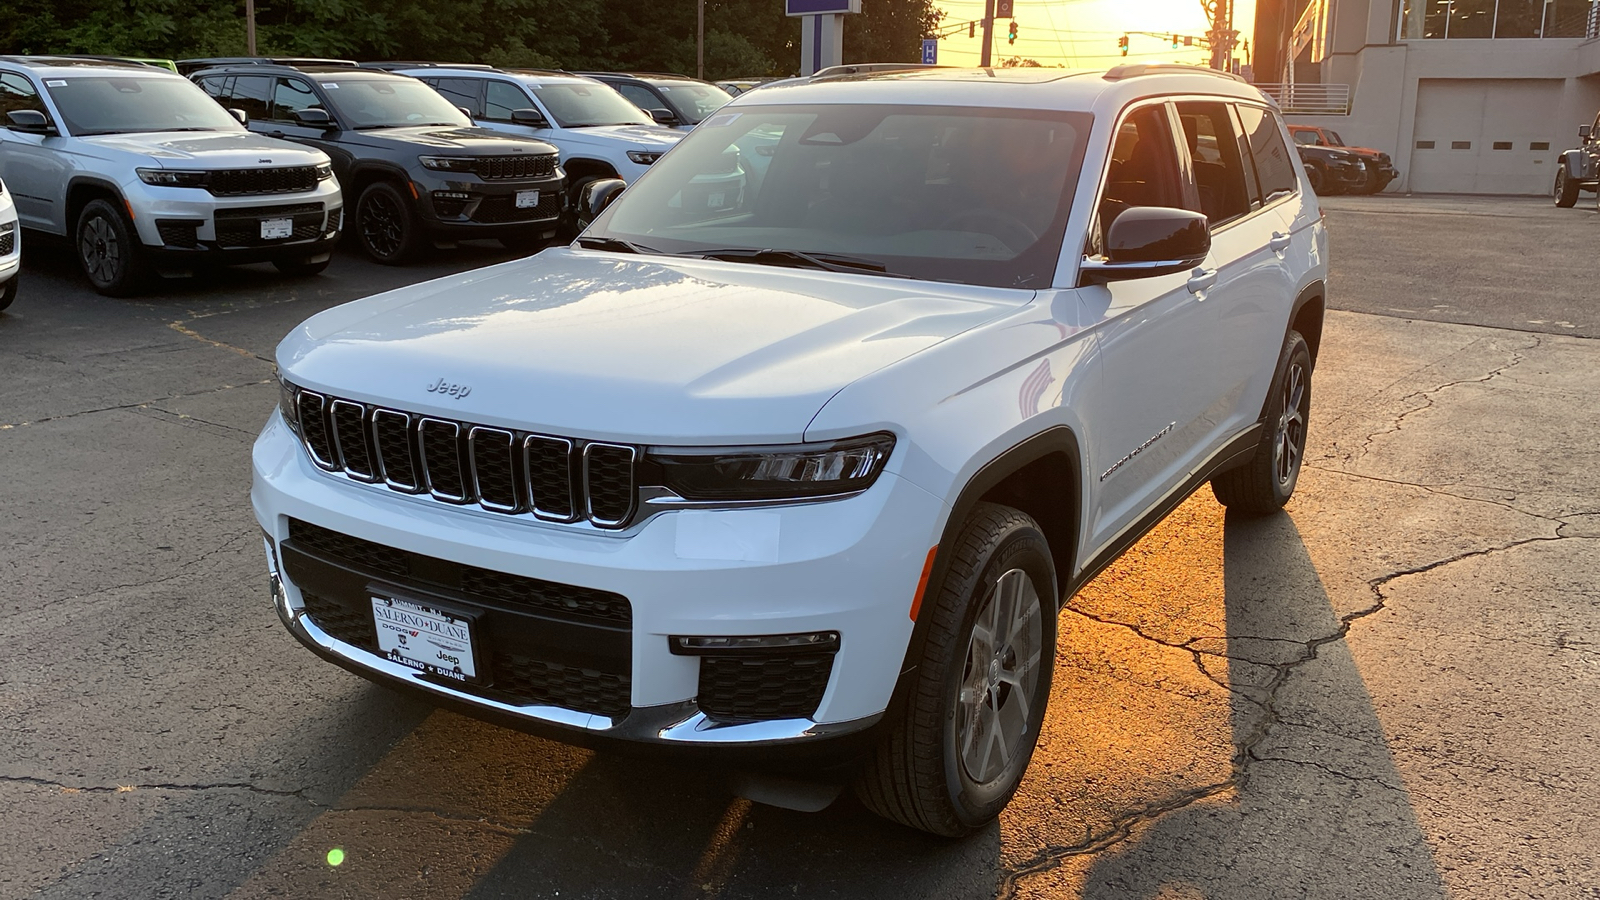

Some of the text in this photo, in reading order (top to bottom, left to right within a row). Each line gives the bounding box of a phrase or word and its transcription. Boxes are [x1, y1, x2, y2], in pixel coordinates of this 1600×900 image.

[926, 46, 934, 57] H
[426, 377, 472, 400] Jeep
[375, 607, 468, 641] SALERNO DUANE
[387, 653, 465, 681] SALERNO DUANE
[436, 650, 460, 665] Jeep
